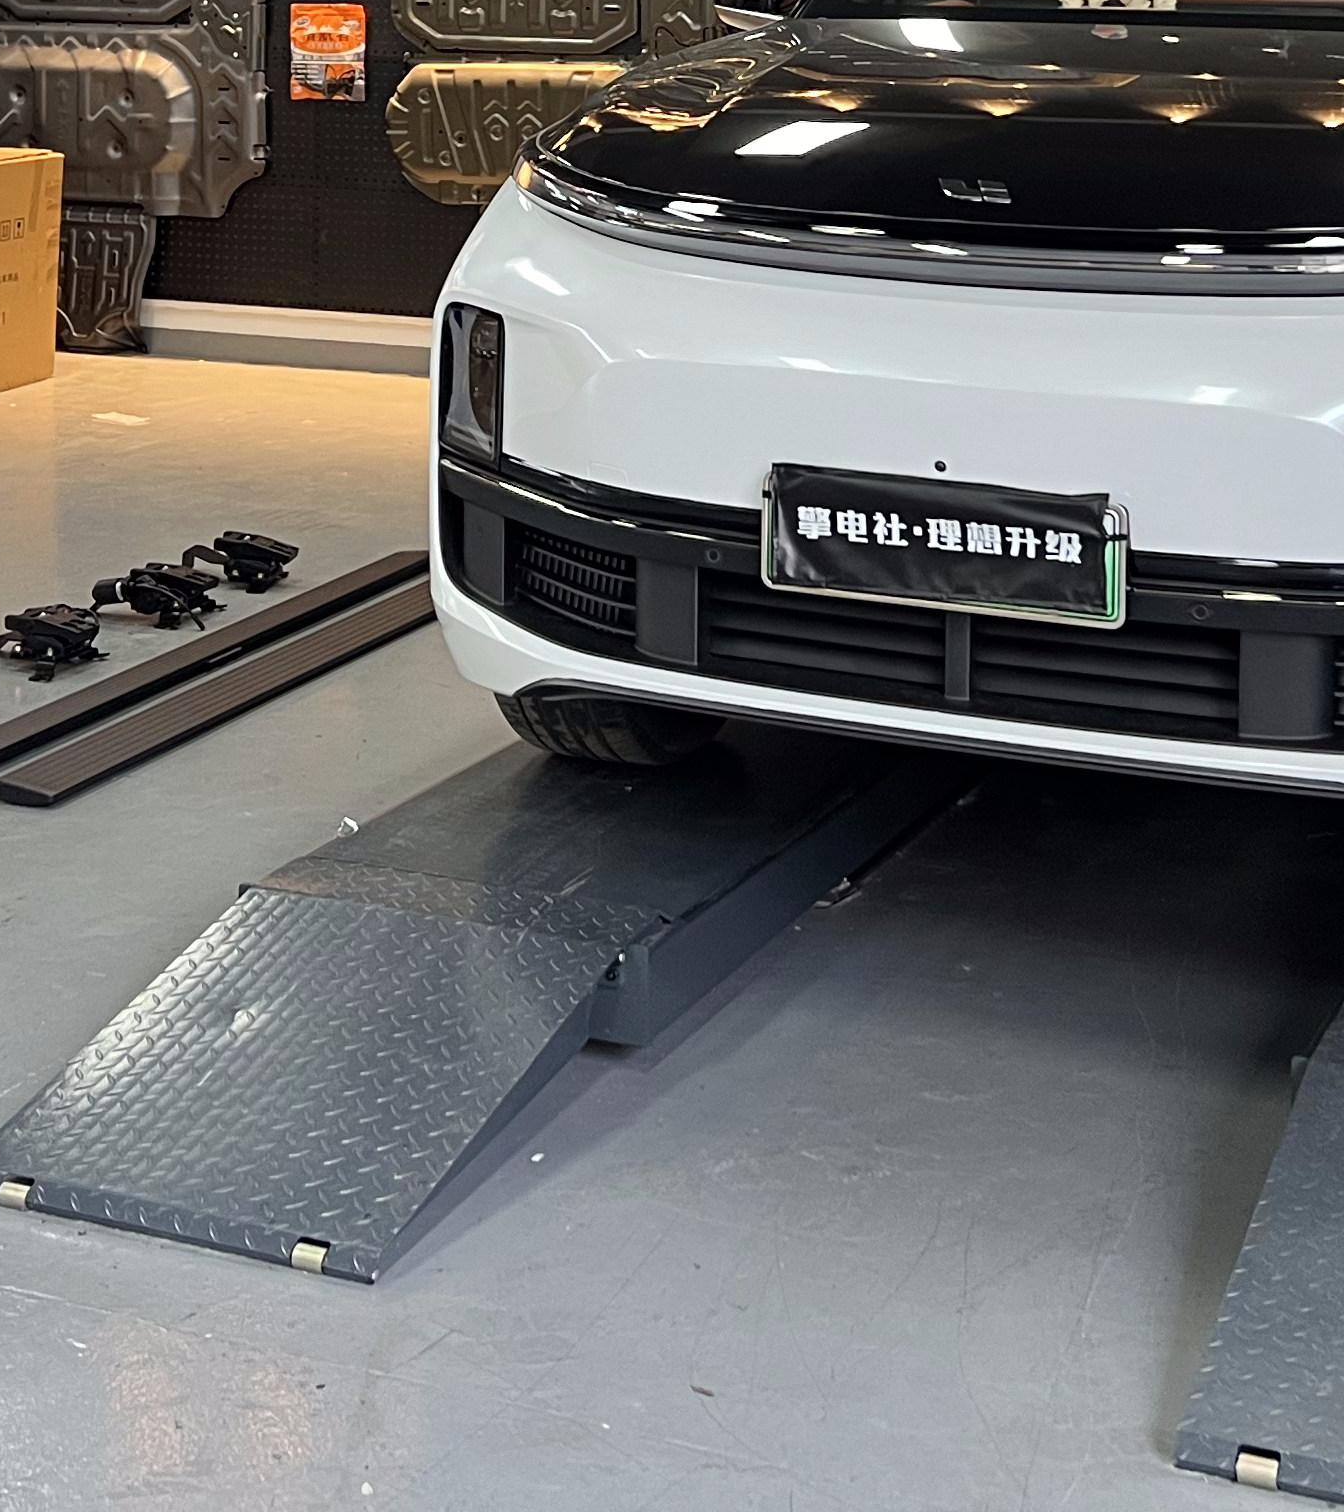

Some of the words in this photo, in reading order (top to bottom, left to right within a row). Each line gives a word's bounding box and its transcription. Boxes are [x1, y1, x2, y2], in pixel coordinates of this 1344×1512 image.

[796, 505, 1083, 566] 擎电社·理想升级
